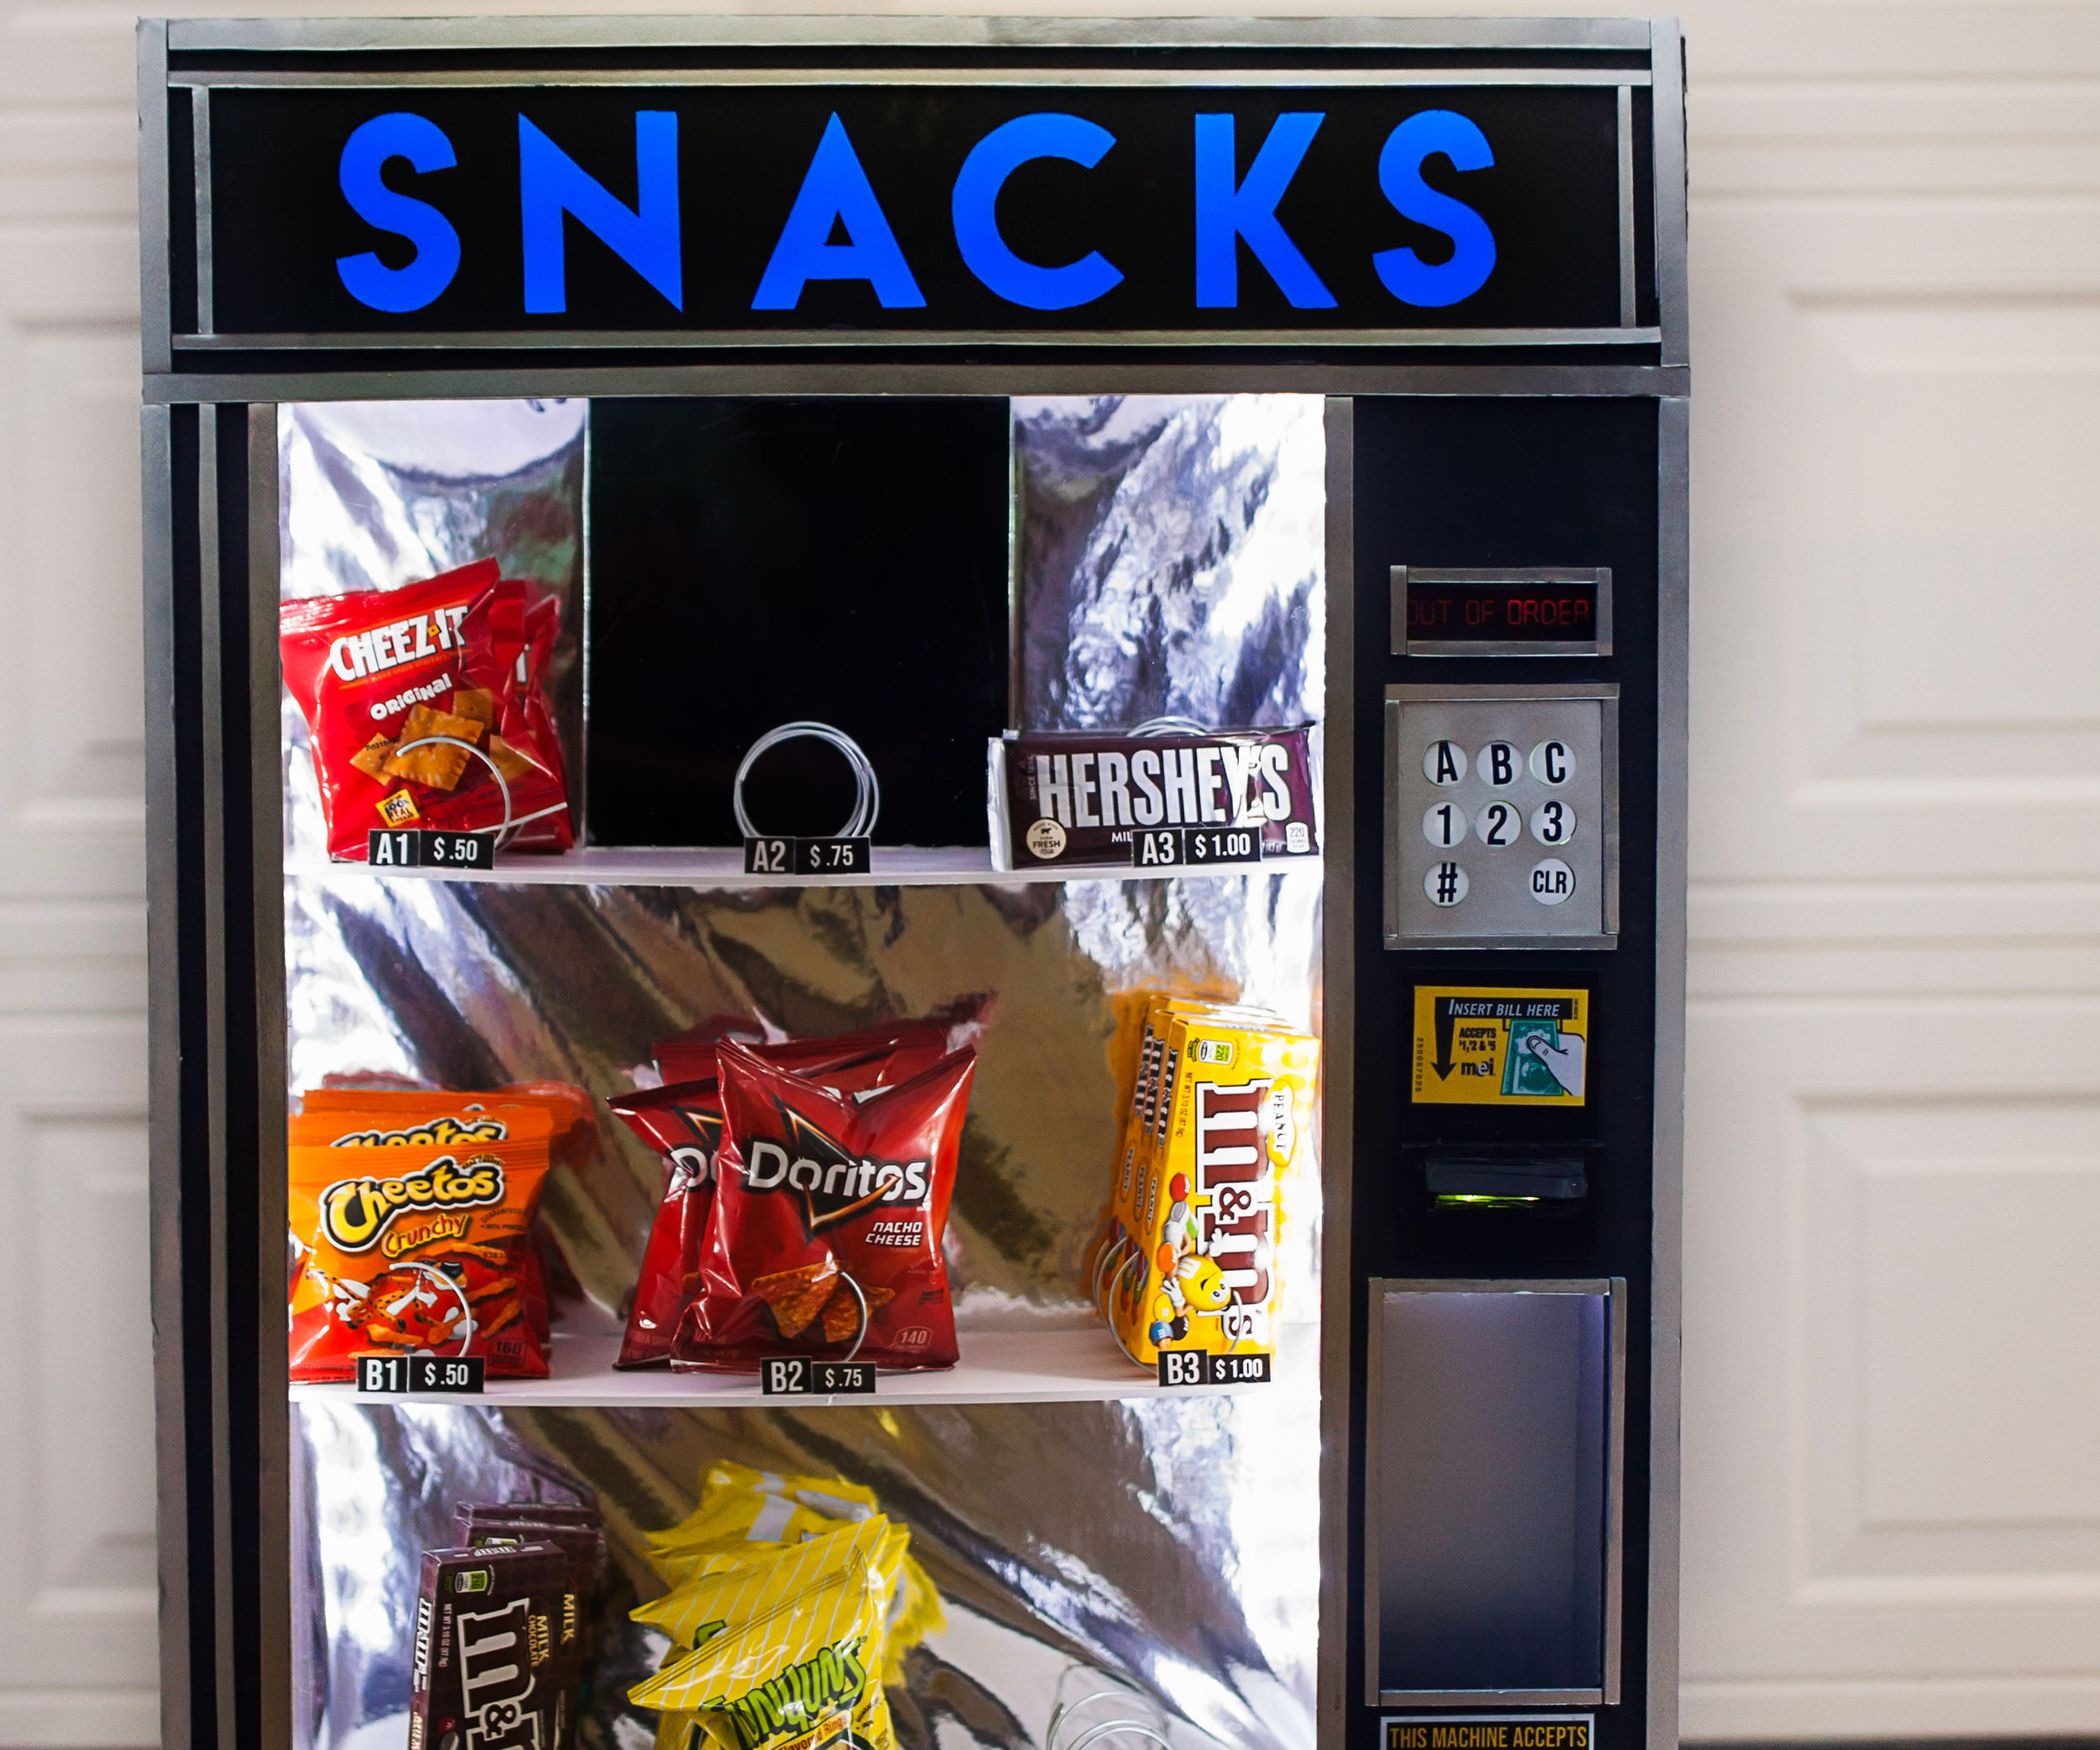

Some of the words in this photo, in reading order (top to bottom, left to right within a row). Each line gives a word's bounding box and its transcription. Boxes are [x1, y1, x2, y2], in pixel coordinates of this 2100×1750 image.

[335, 109, 1497, 314] SNACKS
[1465, 600, 1495, 626] OF
[1507, 600, 1590, 626] ORDER
[1436, 741, 1459, 784] A
[1490, 743, 1513, 785] B
[1544, 742, 1567, 784] C
[1111, 831, 1133, 843] MIL
[1436, 804, 1452, 845] 1
[1486, 804, 1506, 846] 2
[1542, 801, 1563, 843] 3
[375, 832, 408, 865] A1
[752, 840, 786, 872] A2
[1032, 839, 1061, 849] FRESH
[1142, 831, 1175, 865] A3
[1211, 833, 1251, 856] 1.00
[1532, 870, 1568, 894] CLR
[1449, 998, 1493, 1017] INSERT
[1496, 1003, 1522, 1017] BILL
[1526, 1004, 1560, 1018] HERE
[1458, 1026, 1497, 1039] ACCEPTS
[1479, 1041, 1487, 1051] &
[1460, 1058, 1496, 1077] mei
[1273, 1094, 1286, 1149] PEANUT
[747, 1141, 927, 1201] Doritos
[324, 1160, 500, 1248] Cheetos
[1147, 1179, 1157, 1223] PEANUT
[384, 1213, 467, 1257] Crunchy
[865, 1233, 922, 1246] CHEESE
[872, 1221, 923, 1233] NACHO
[900, 1330, 928, 1345] 140
[366, 1359, 398, 1391] B1
[770, 1360, 804, 1392] B2
[1166, 1352, 1201, 1385] B3
[1229, 1358, 1264, 1379] 1.00
[560, 1593, 576, 1645] MILK
[527, 1614, 540, 1667] CHOCOLATE
[536, 1615, 550, 1664] MILK
[1389, 1727, 1428, 1749] THIS
[1432, 1726, 1508, 1749] MACHINE
[1512, 1725, 1587, 1748] ACCEPTS
